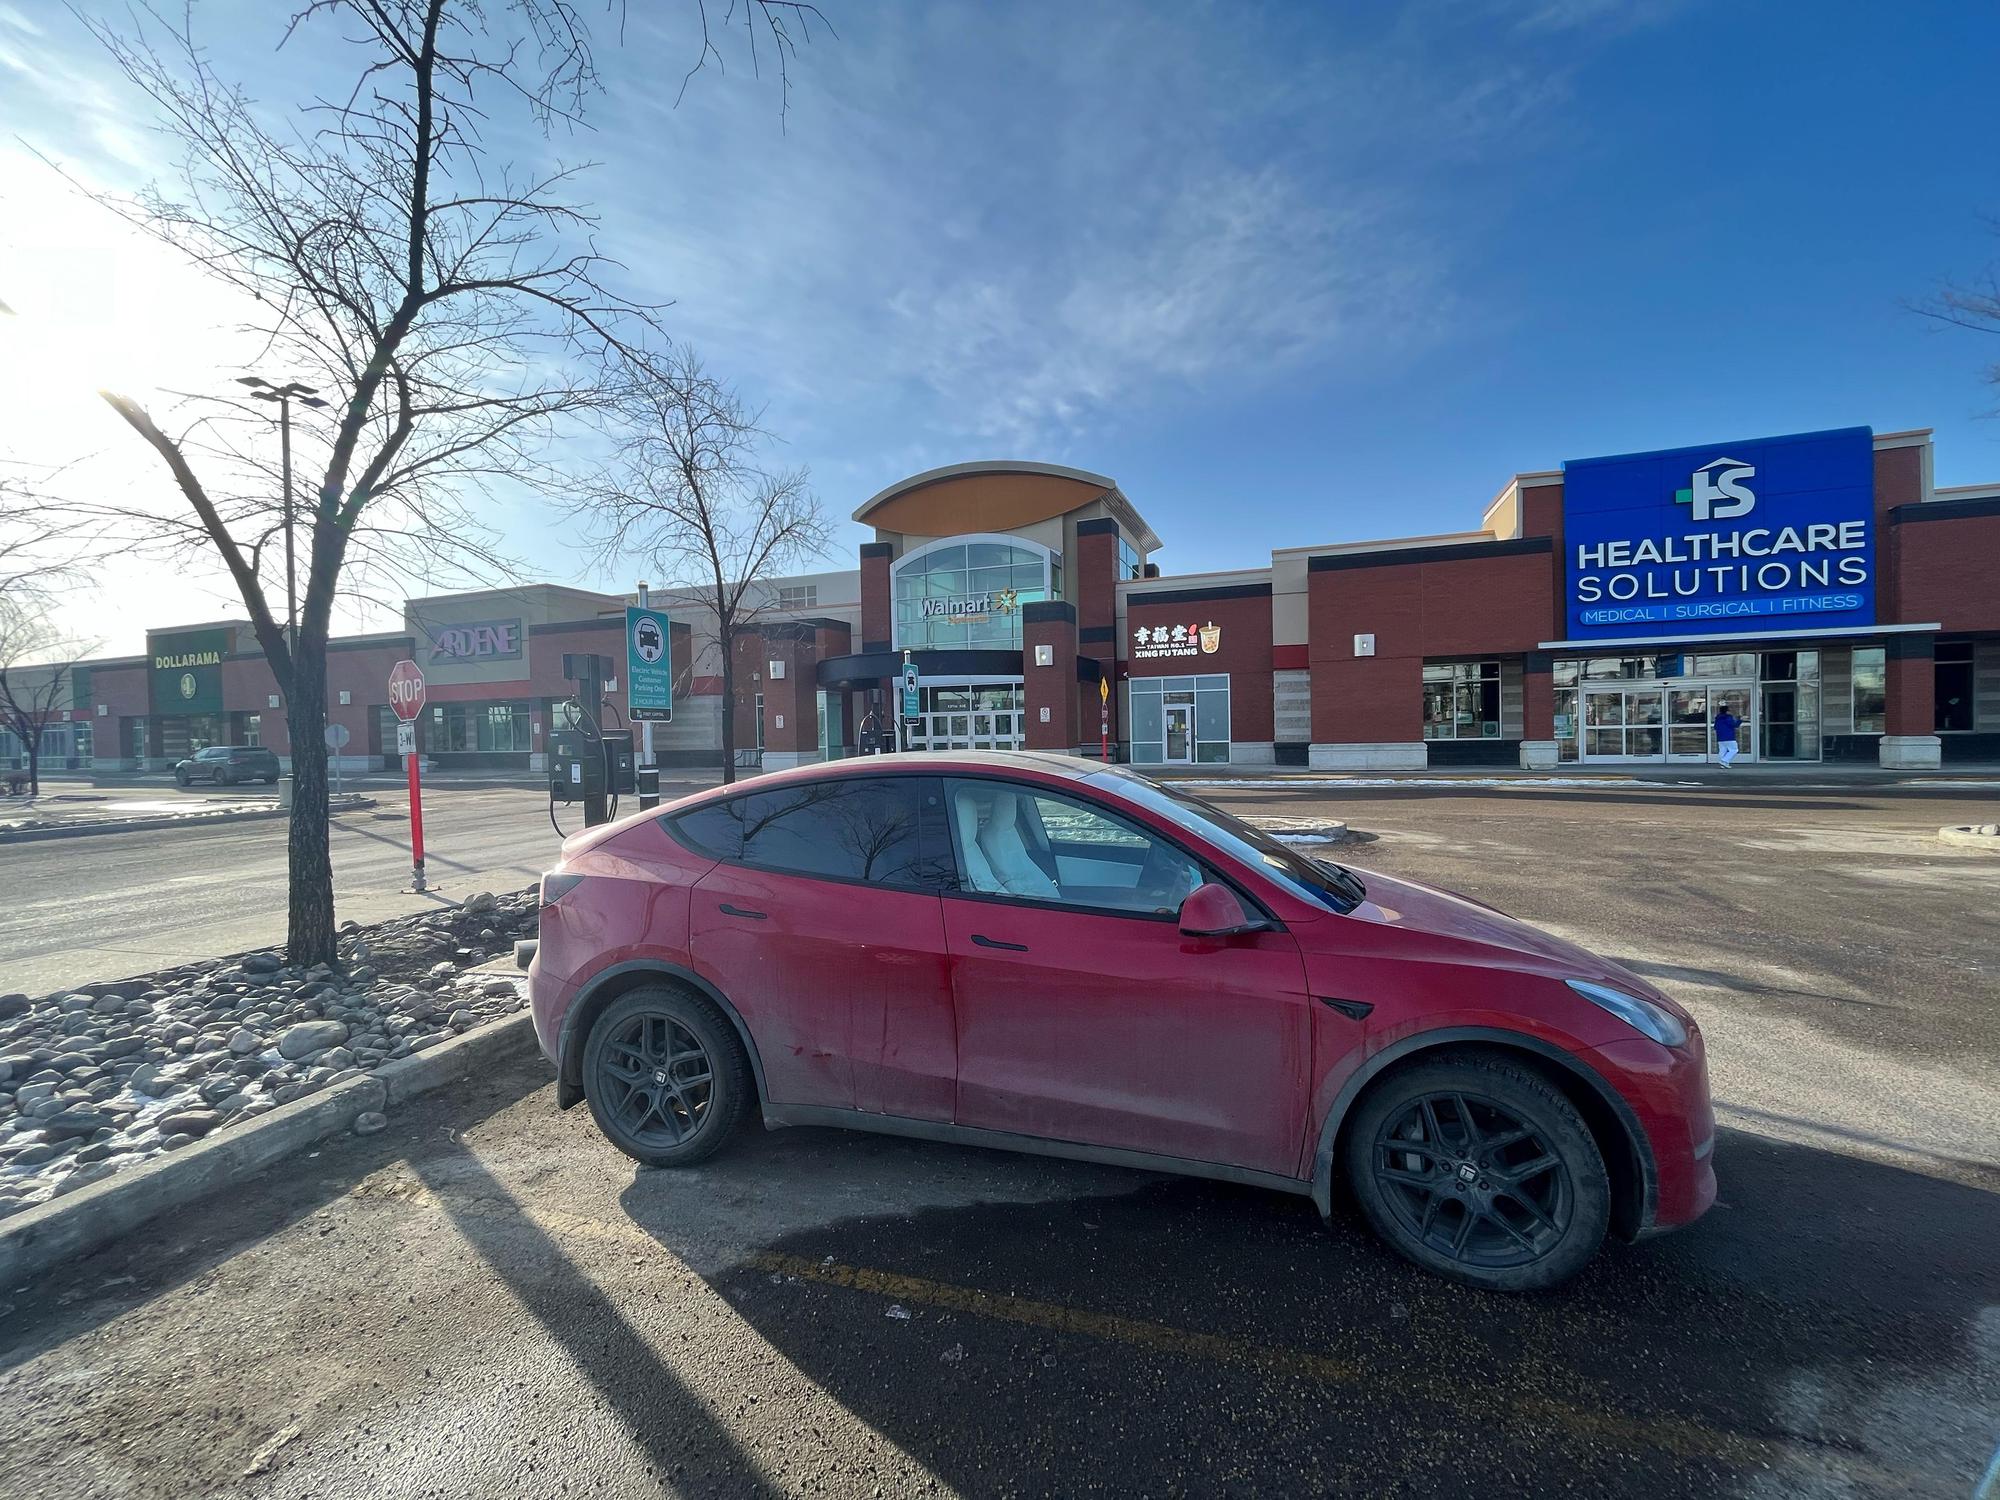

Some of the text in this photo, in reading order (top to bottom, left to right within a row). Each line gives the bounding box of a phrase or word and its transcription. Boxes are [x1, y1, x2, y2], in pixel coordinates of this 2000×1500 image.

[1578, 520, 1866, 569] HEALTHCARE
[1577, 556, 1867, 602] SOLUTIONS
[921, 592, 990, 616] Walmart
[1585, 595, 1858, 622] MEDICAL SURGICAL FITNESS
[433, 624, 517, 658] ARDENE
[1135, 648, 1198, 659] XING FU TANG
[156, 651, 220, 669] DOLLARAMA
[391, 679, 422, 704] STOP
